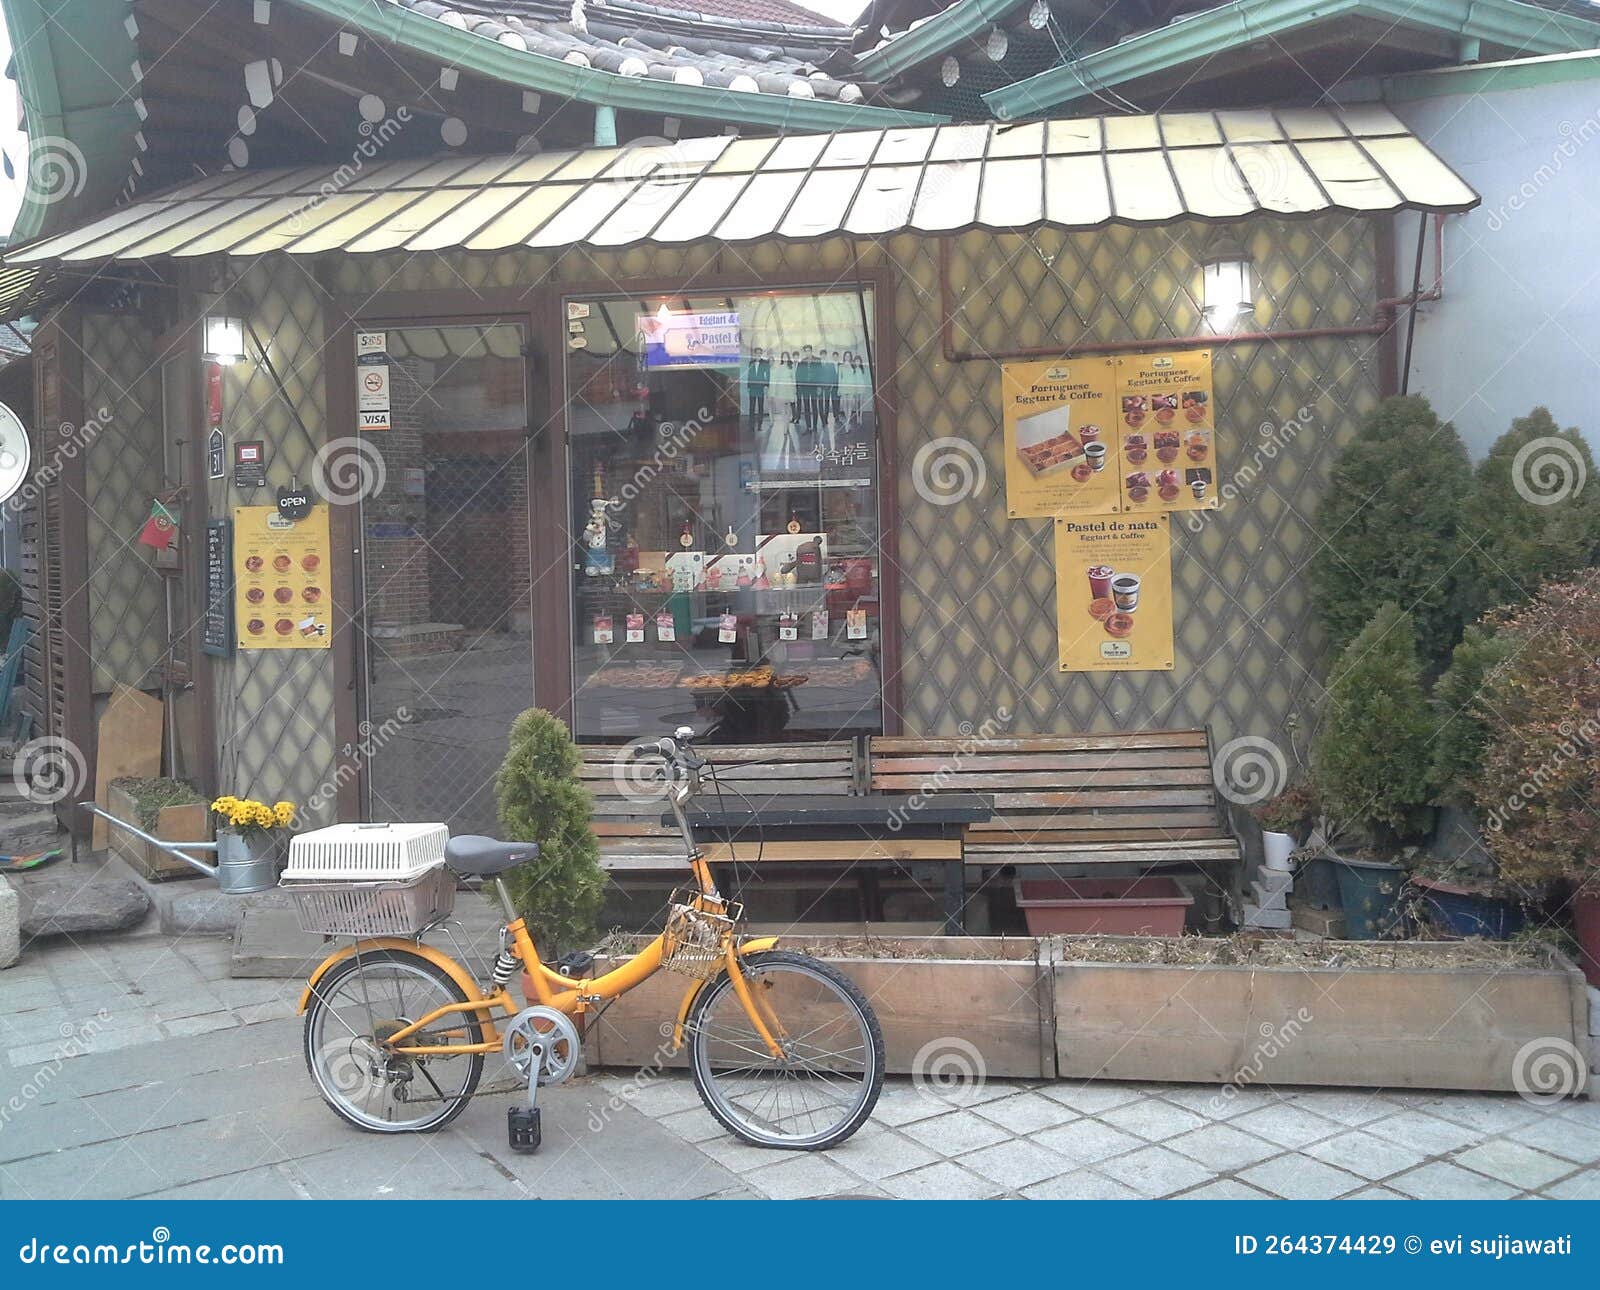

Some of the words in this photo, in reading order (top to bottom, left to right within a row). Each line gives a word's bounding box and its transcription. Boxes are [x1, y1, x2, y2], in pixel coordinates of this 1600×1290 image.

[701, 332, 732, 344] Pastel
[1139, 369, 1189, 378] Portuguese
[1127, 378, 1161, 387] Eggtart
[1173, 374, 1201, 383] Coffee
[1031, 384, 1090, 393] Portuguese
[1016, 394, 1056, 405] Eggtart
[1058, 393, 1066, 401] &
[1070, 391, 1103, 400] Coffee
[364, 415, 387, 424] VISA
[280, 497, 306, 507] OPEN
[1067, 522, 1106, 532] Pastel
[1109, 522, 1125, 531] de
[1128, 521, 1157, 530] nata
